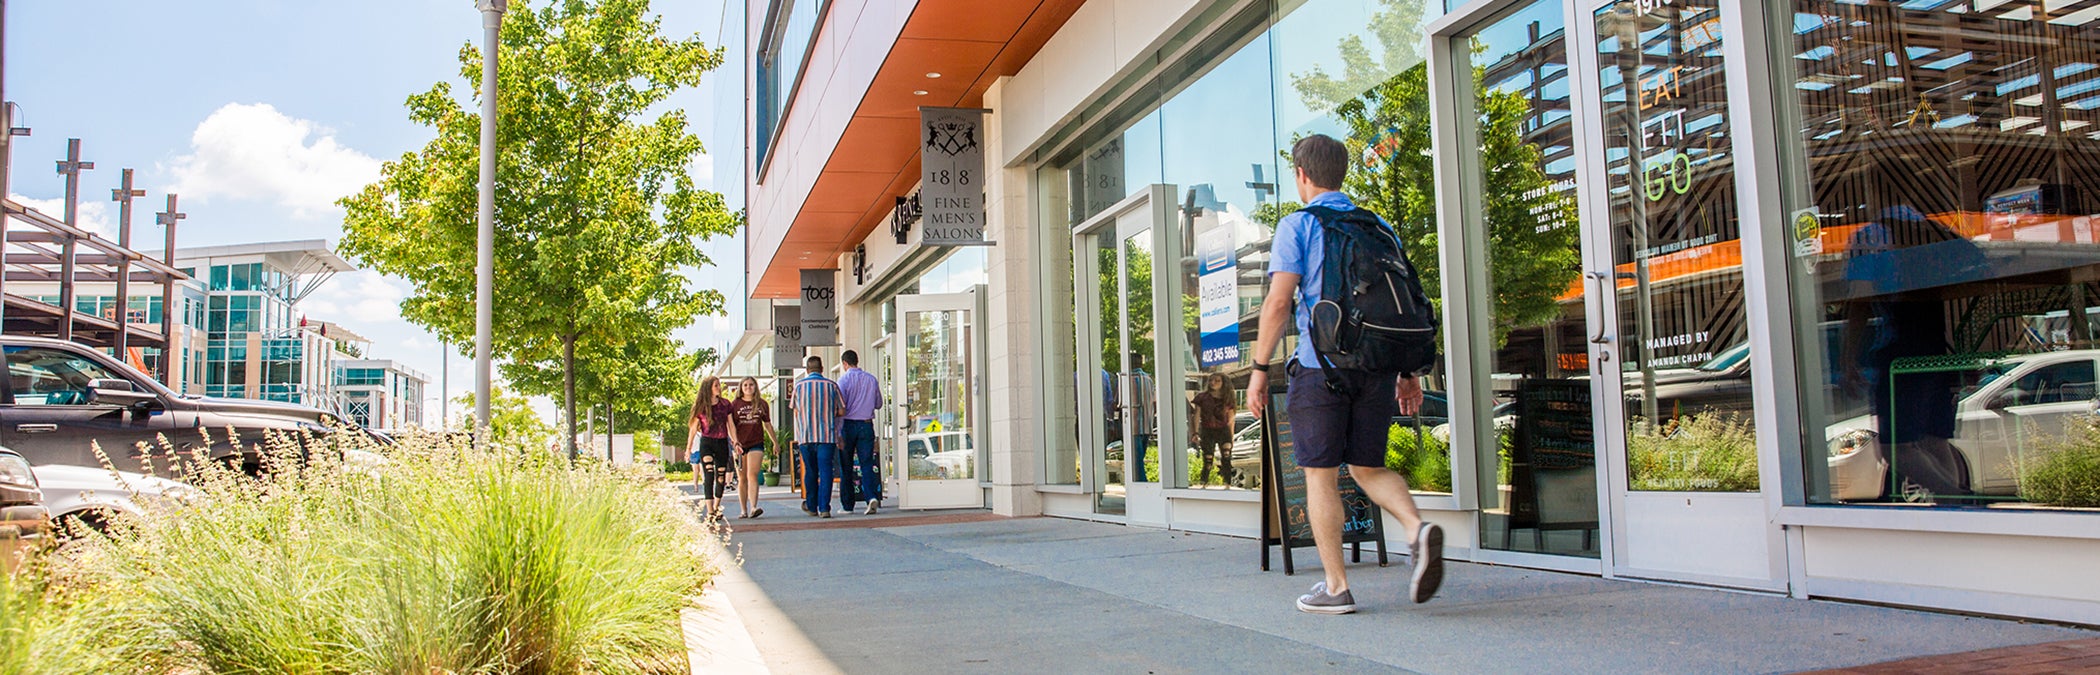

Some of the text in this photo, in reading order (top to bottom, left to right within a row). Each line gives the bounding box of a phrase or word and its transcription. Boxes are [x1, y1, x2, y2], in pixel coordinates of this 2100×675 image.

[1638, 65, 1683, 110] EAT
[1640, 108, 1686, 150] FIT
[1646, 153, 1691, 201] GO
[1522, 178, 1574, 201] STORE HOURS
[935, 197, 971, 209] FINE
[931, 212, 975, 224] MEN'S
[924, 228, 982, 240] SALONS
[802, 285, 834, 309] togs
[1202, 280, 1232, 303] Available
[1646, 331, 1709, 350] MANAGED BY
[1213, 347, 1224, 361] 345
[1647, 352, 1713, 368] AMANDA CHAPIN
